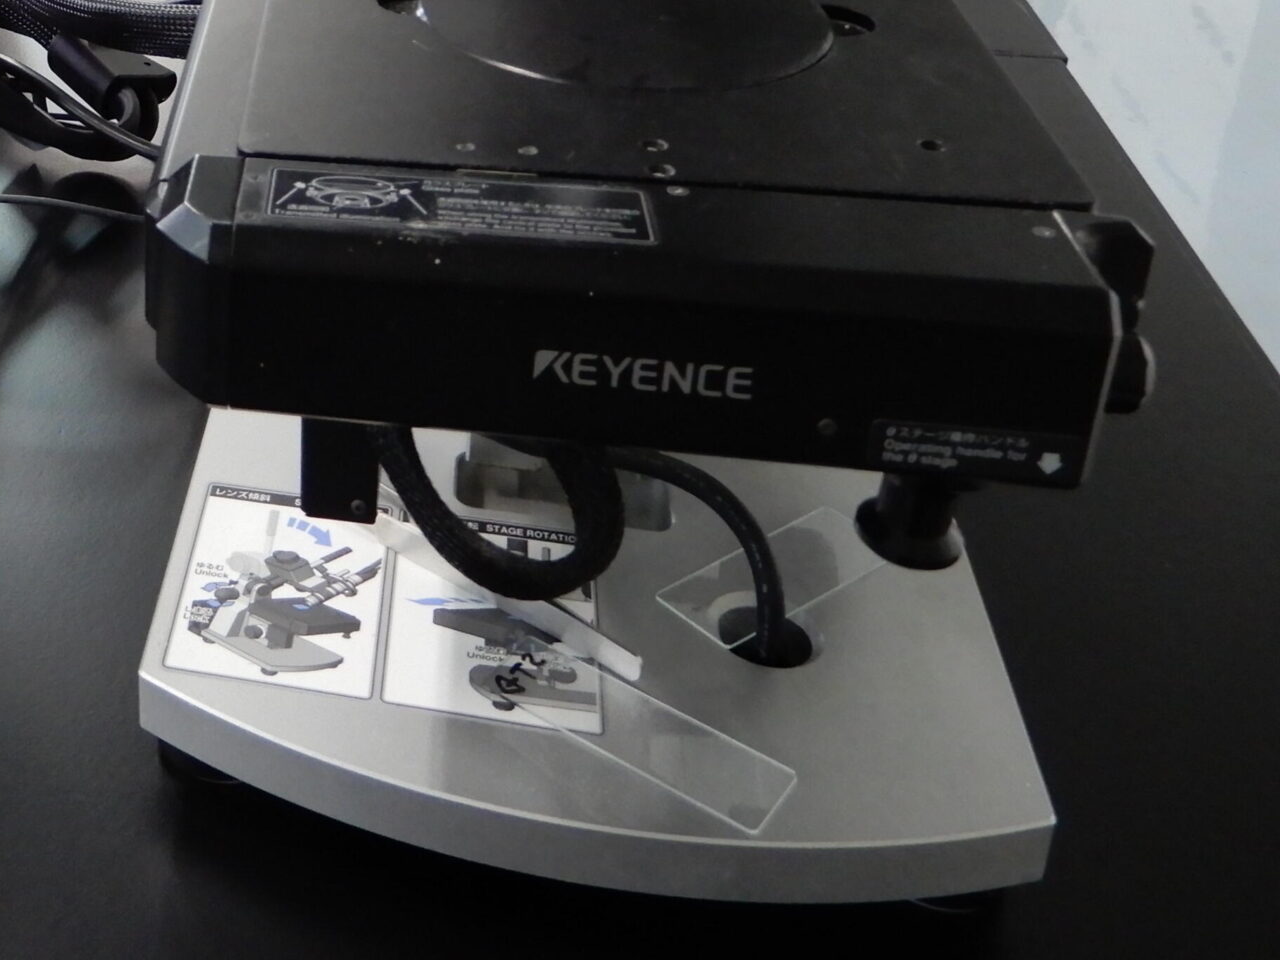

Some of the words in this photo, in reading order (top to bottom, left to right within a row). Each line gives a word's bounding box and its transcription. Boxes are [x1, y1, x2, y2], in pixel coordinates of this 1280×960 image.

[532, 349, 754, 400] KEYENCE
[216, 488, 270, 503] レンズ傾斜
[486, 524, 524, 537] STAGE
[526, 529, 577, 542] ROTATIO
[194, 568, 229, 579] Unlock
[467, 651, 504, 662] Unlock
